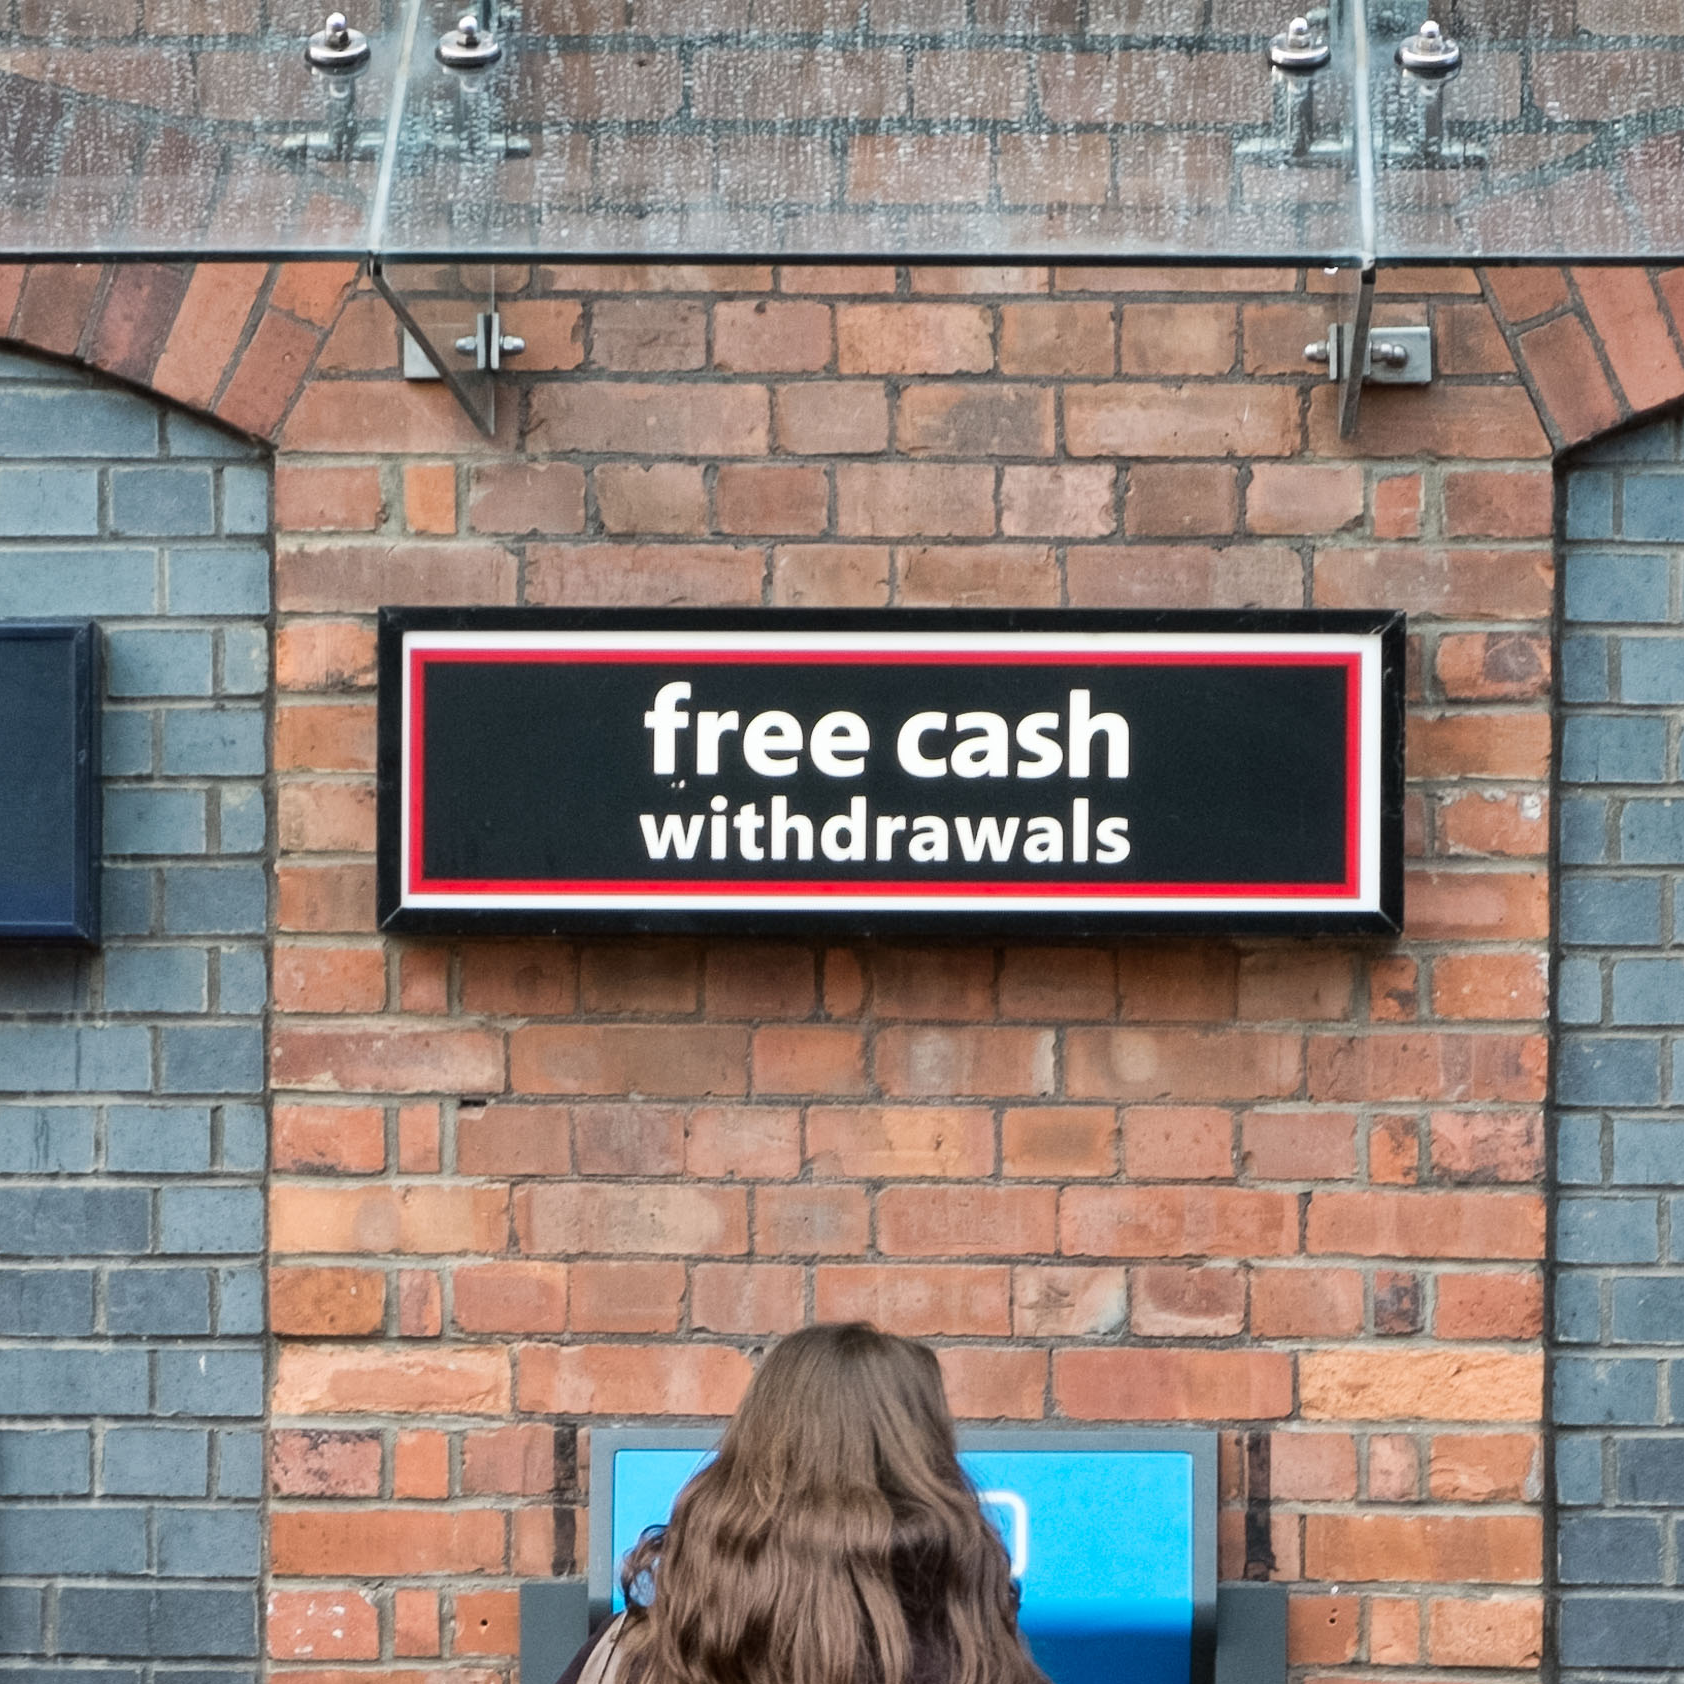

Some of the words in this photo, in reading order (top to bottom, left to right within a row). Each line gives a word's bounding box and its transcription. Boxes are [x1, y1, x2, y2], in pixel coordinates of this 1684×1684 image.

[643, 681, 871, 778] free
[896, 688, 1130, 779] cash
[639, 794, 1131, 864] withdrawals
